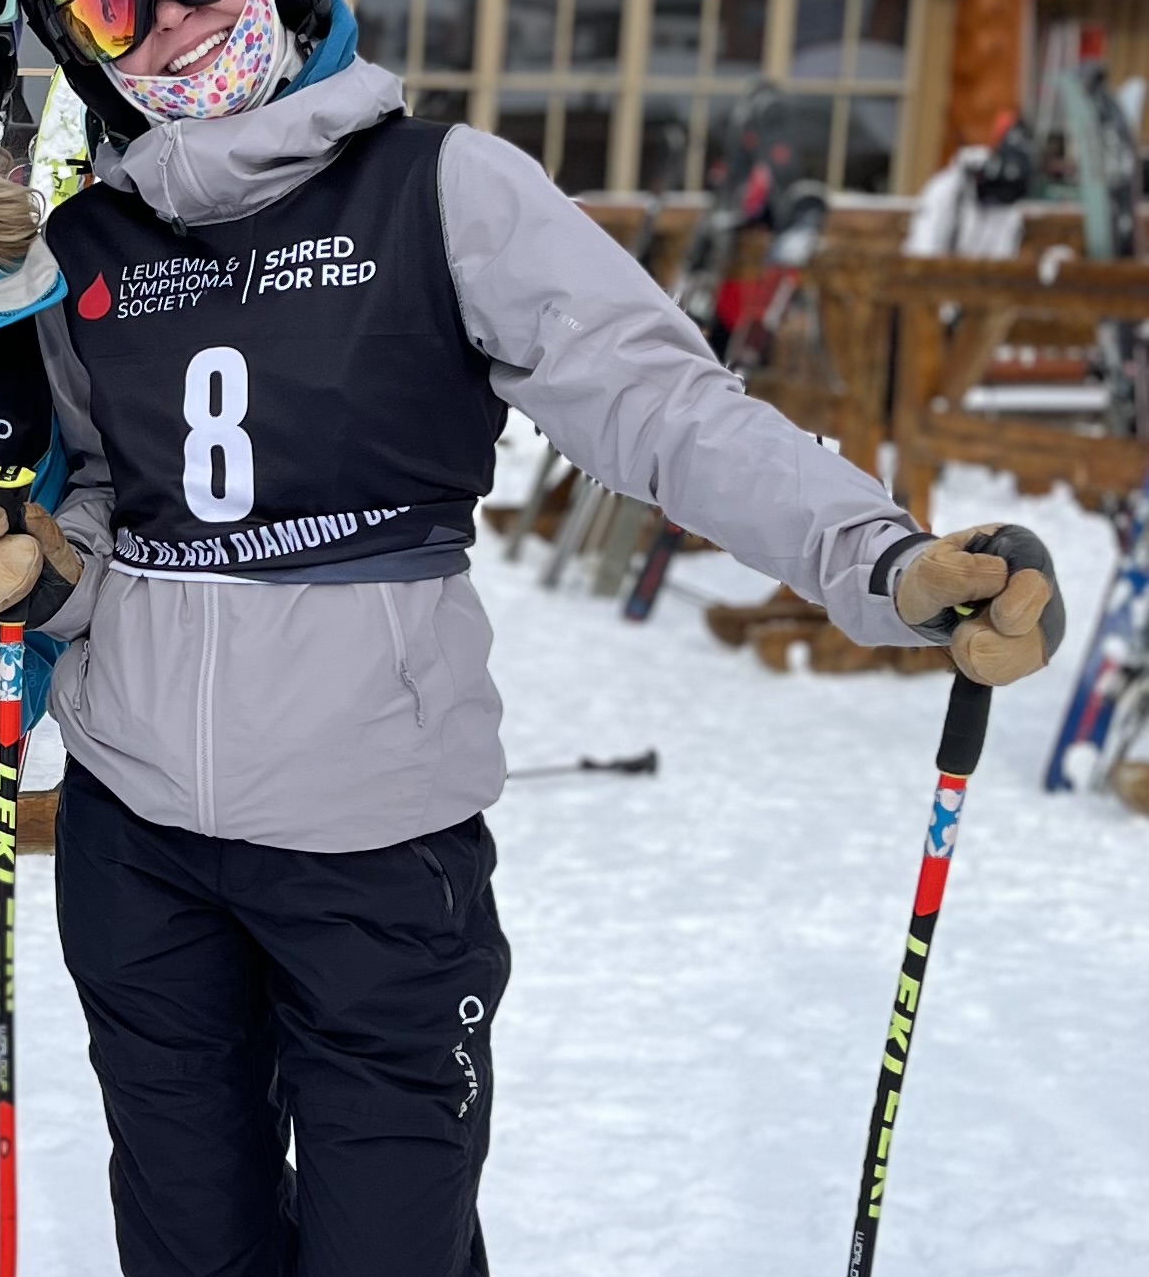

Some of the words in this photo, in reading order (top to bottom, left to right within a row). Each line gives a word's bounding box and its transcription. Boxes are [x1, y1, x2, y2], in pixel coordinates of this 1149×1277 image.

[121, 257, 220, 282] LEUKEMIA
[225, 256, 241, 273] &
[264, 236, 355, 271] SHRED
[118, 273, 234, 300] LYMPHOMA
[258, 267, 314, 295] FOR
[321, 260, 377, 287] RED
[117, 290, 204, 320] SOCIETY
[183, 345, 255, 523] 8
[152, 536, 230, 567] BLACK
[229, 512, 359, 563] DIAMOND
